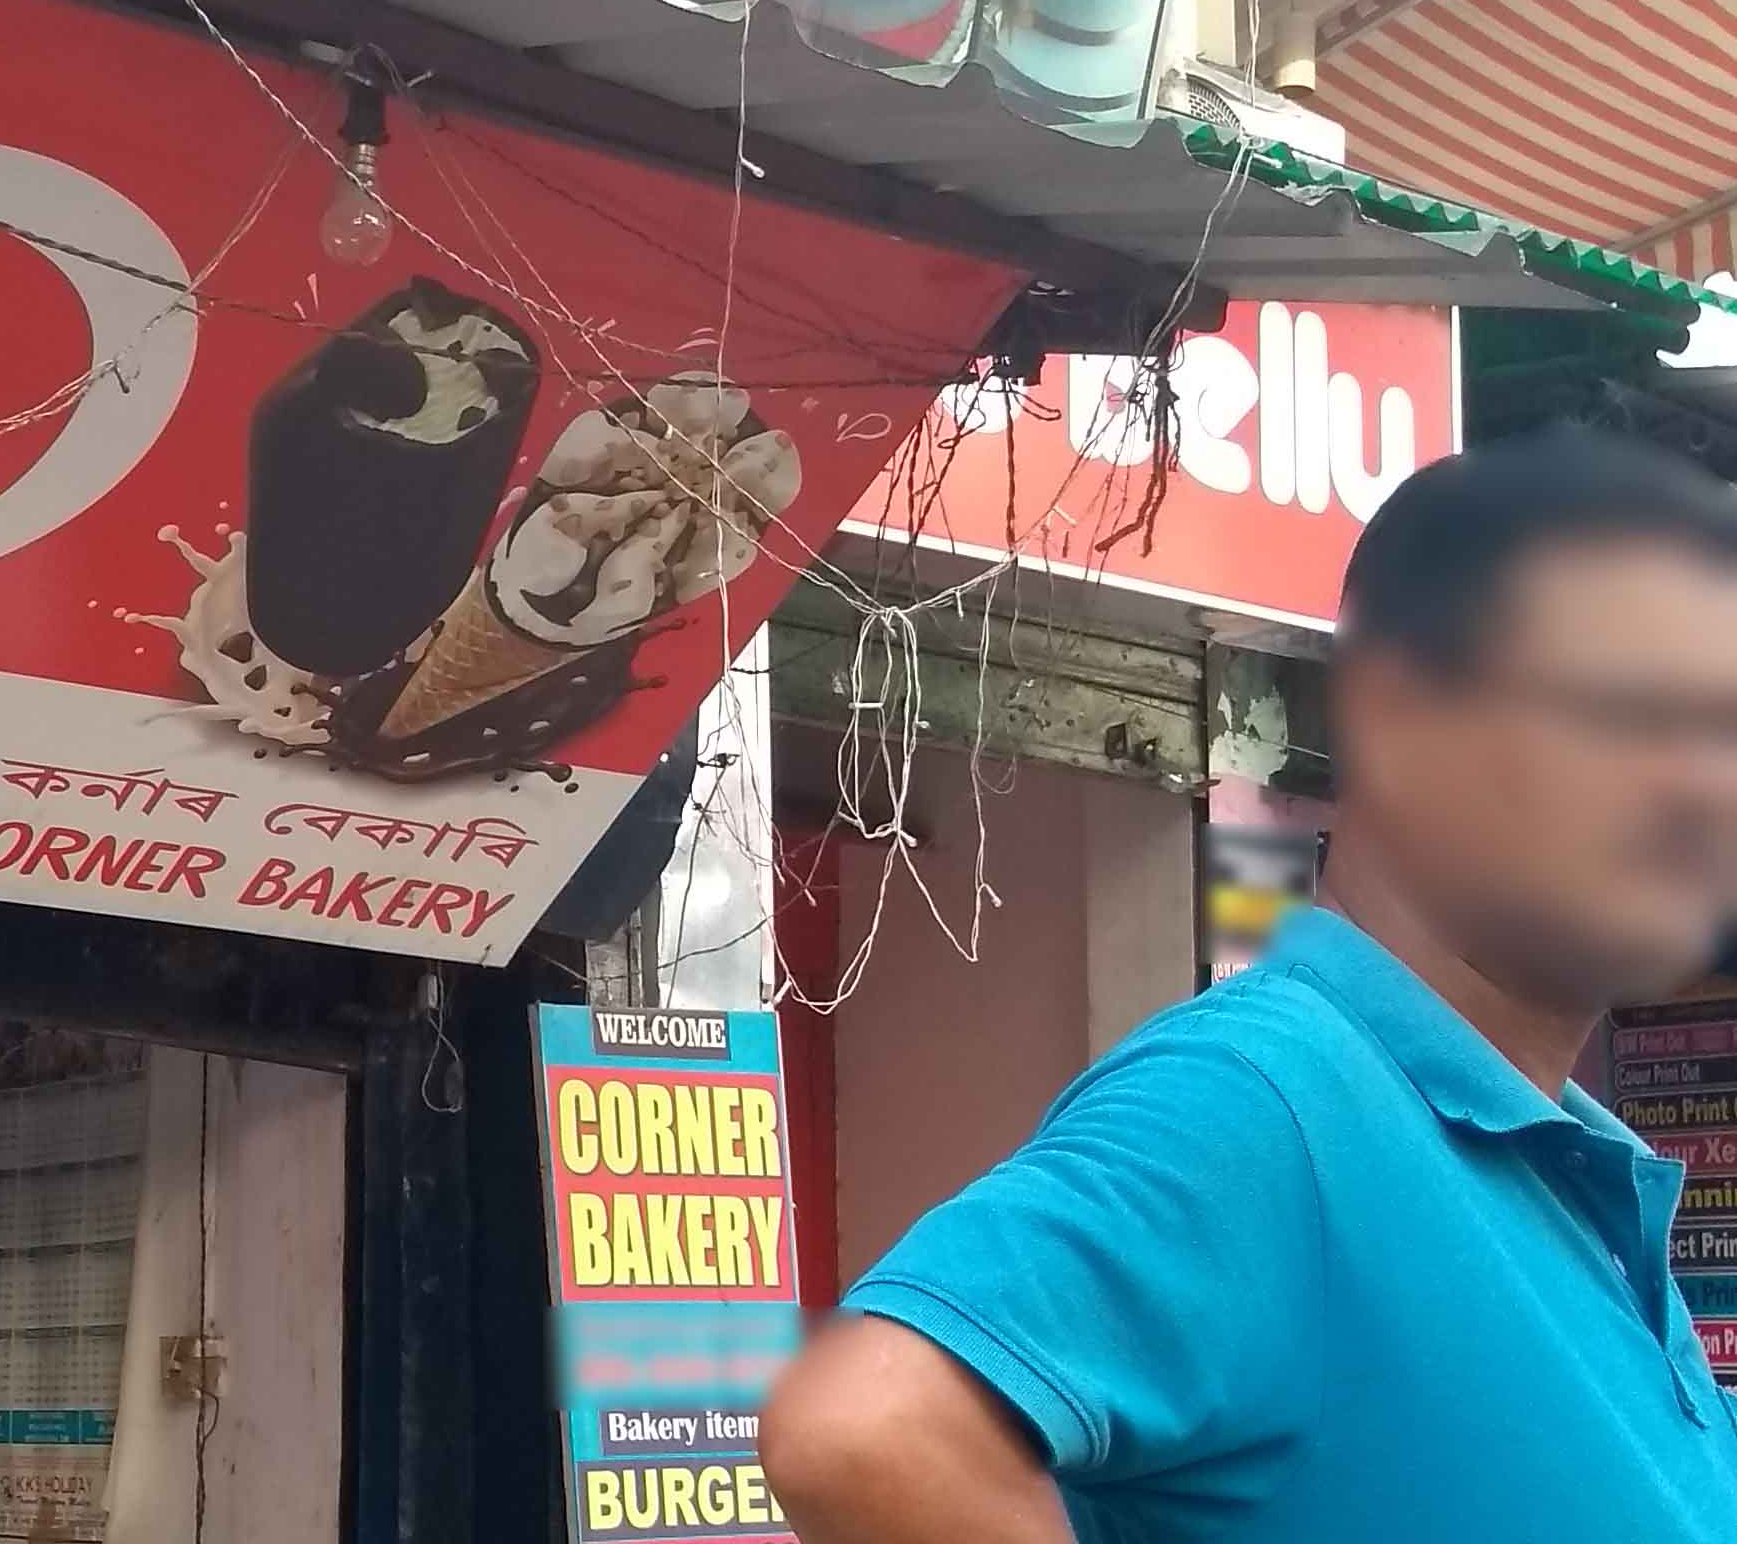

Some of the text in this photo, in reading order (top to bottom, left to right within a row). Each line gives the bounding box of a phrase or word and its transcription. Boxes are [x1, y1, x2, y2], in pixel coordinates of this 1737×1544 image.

[238, 858, 516, 939] BAKERY
[595, 1012, 727, 1049] WELCOME
[559, 1078, 782, 1178] CORNER
[1622, 1097, 1729, 1127] Photo Print
[569, 1192, 784, 1288] BAKERY
[608, 1411, 698, 1446] Bakery
